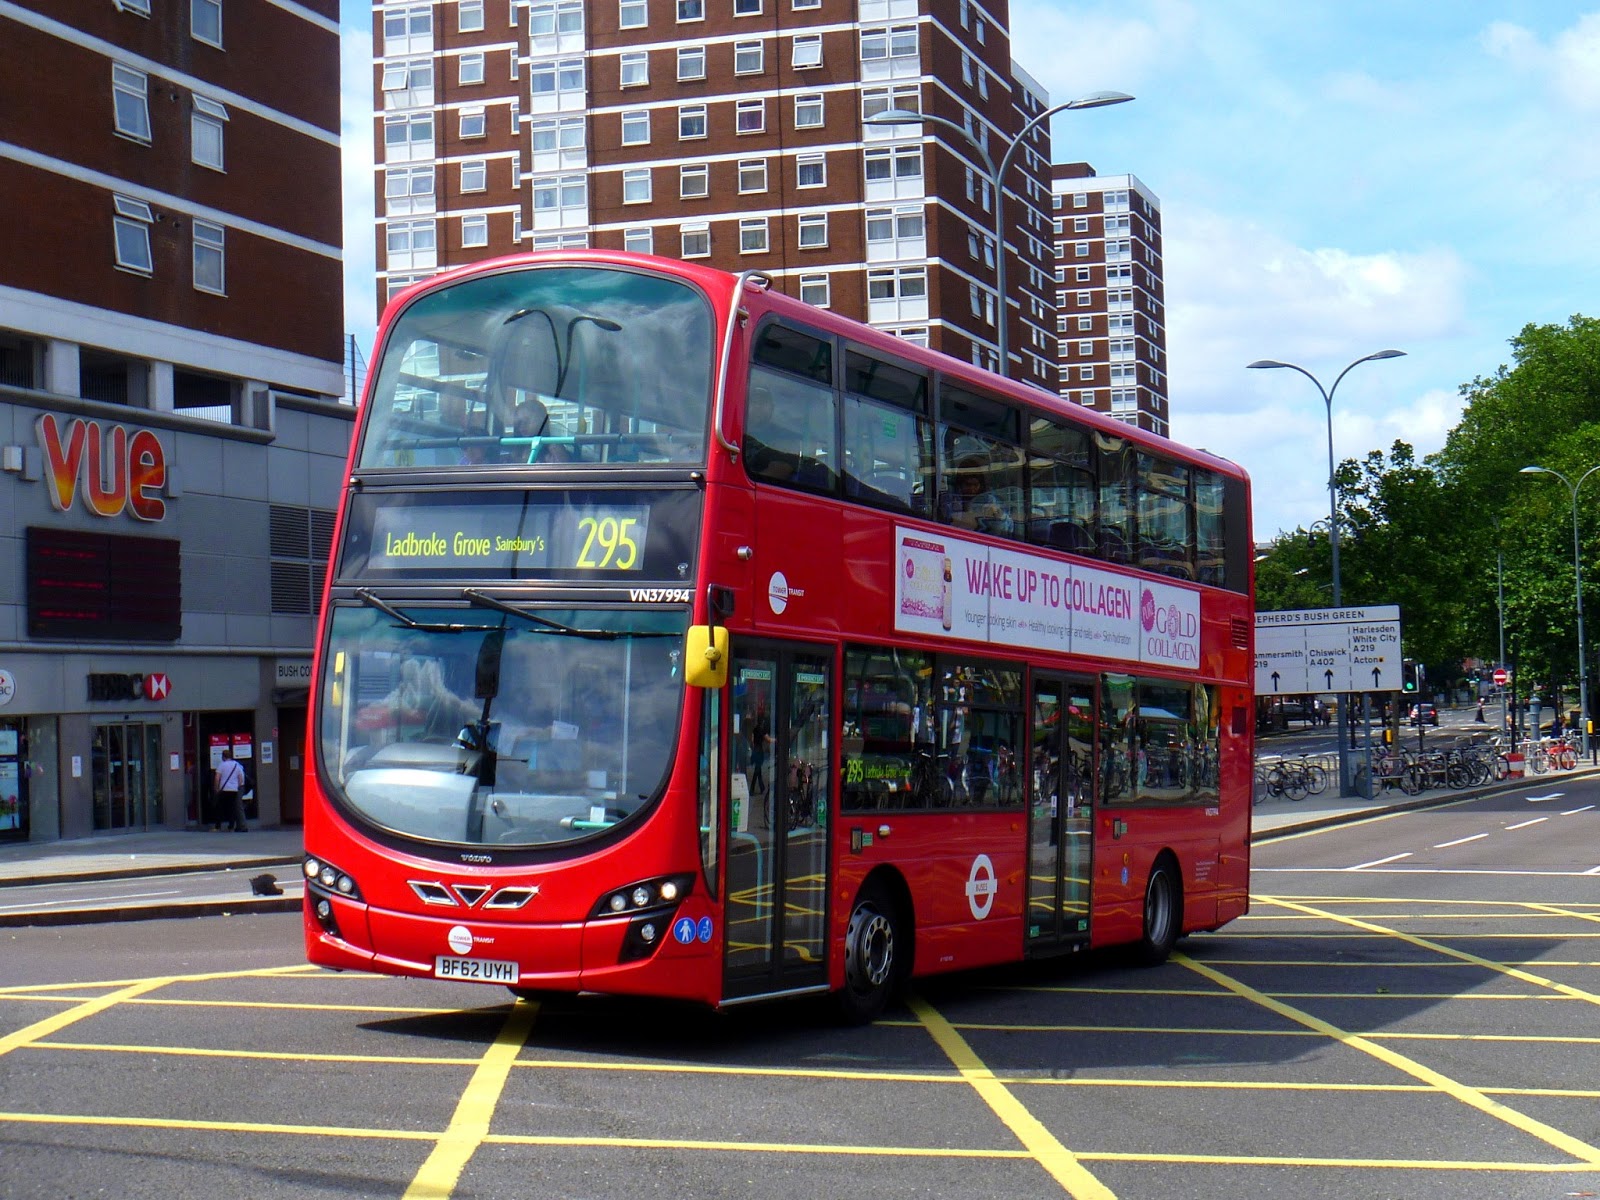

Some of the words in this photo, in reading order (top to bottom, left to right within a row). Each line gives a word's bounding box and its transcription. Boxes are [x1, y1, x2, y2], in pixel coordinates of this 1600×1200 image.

[385, 532, 447, 557] Ladbroke
[453, 531, 491, 557] Grove
[495, 535, 545, 556] Sainsbury's
[576, 516, 637, 570] 295
[965, 557, 1012, 600] WAKE
[1017, 567, 1037, 604] UP
[1041, 572, 1060, 608] TO
[1063, 577, 1131, 620] COLLAGEN
[629, 588, 690, 603] VN37994
[965, 610, 987, 628] Younger
[988, 613, 1006, 631] ooking
[1156, 604, 1197, 640] GOLD
[1254, 613, 1301, 623] EPHERD'S
[1304, 612, 1329, 621] BUSH
[1332, 610, 1365, 619] GREEN
[1352, 625, 1395, 634] Harlesden
[1352, 635, 1377, 643] White
[1380, 634, 1397, 643] City
[1147, 637, 1197, 661] COLLAGEN
[1254, 650, 1304, 659] ammersmith
[1309, 648, 1347, 657] Chiswick
[1254, 660, 1269, 669] 219
[1353, 656, 1379, 664] Acton
[278, 665, 299, 678] BUSH
[847, 760, 864, 783] 295
[461, 854, 492, 864] VOLVO
[472, 936, 495, 944] TRANSIT
[442, 959, 480, 977] BF62
[483, 961, 513, 981] UYH
